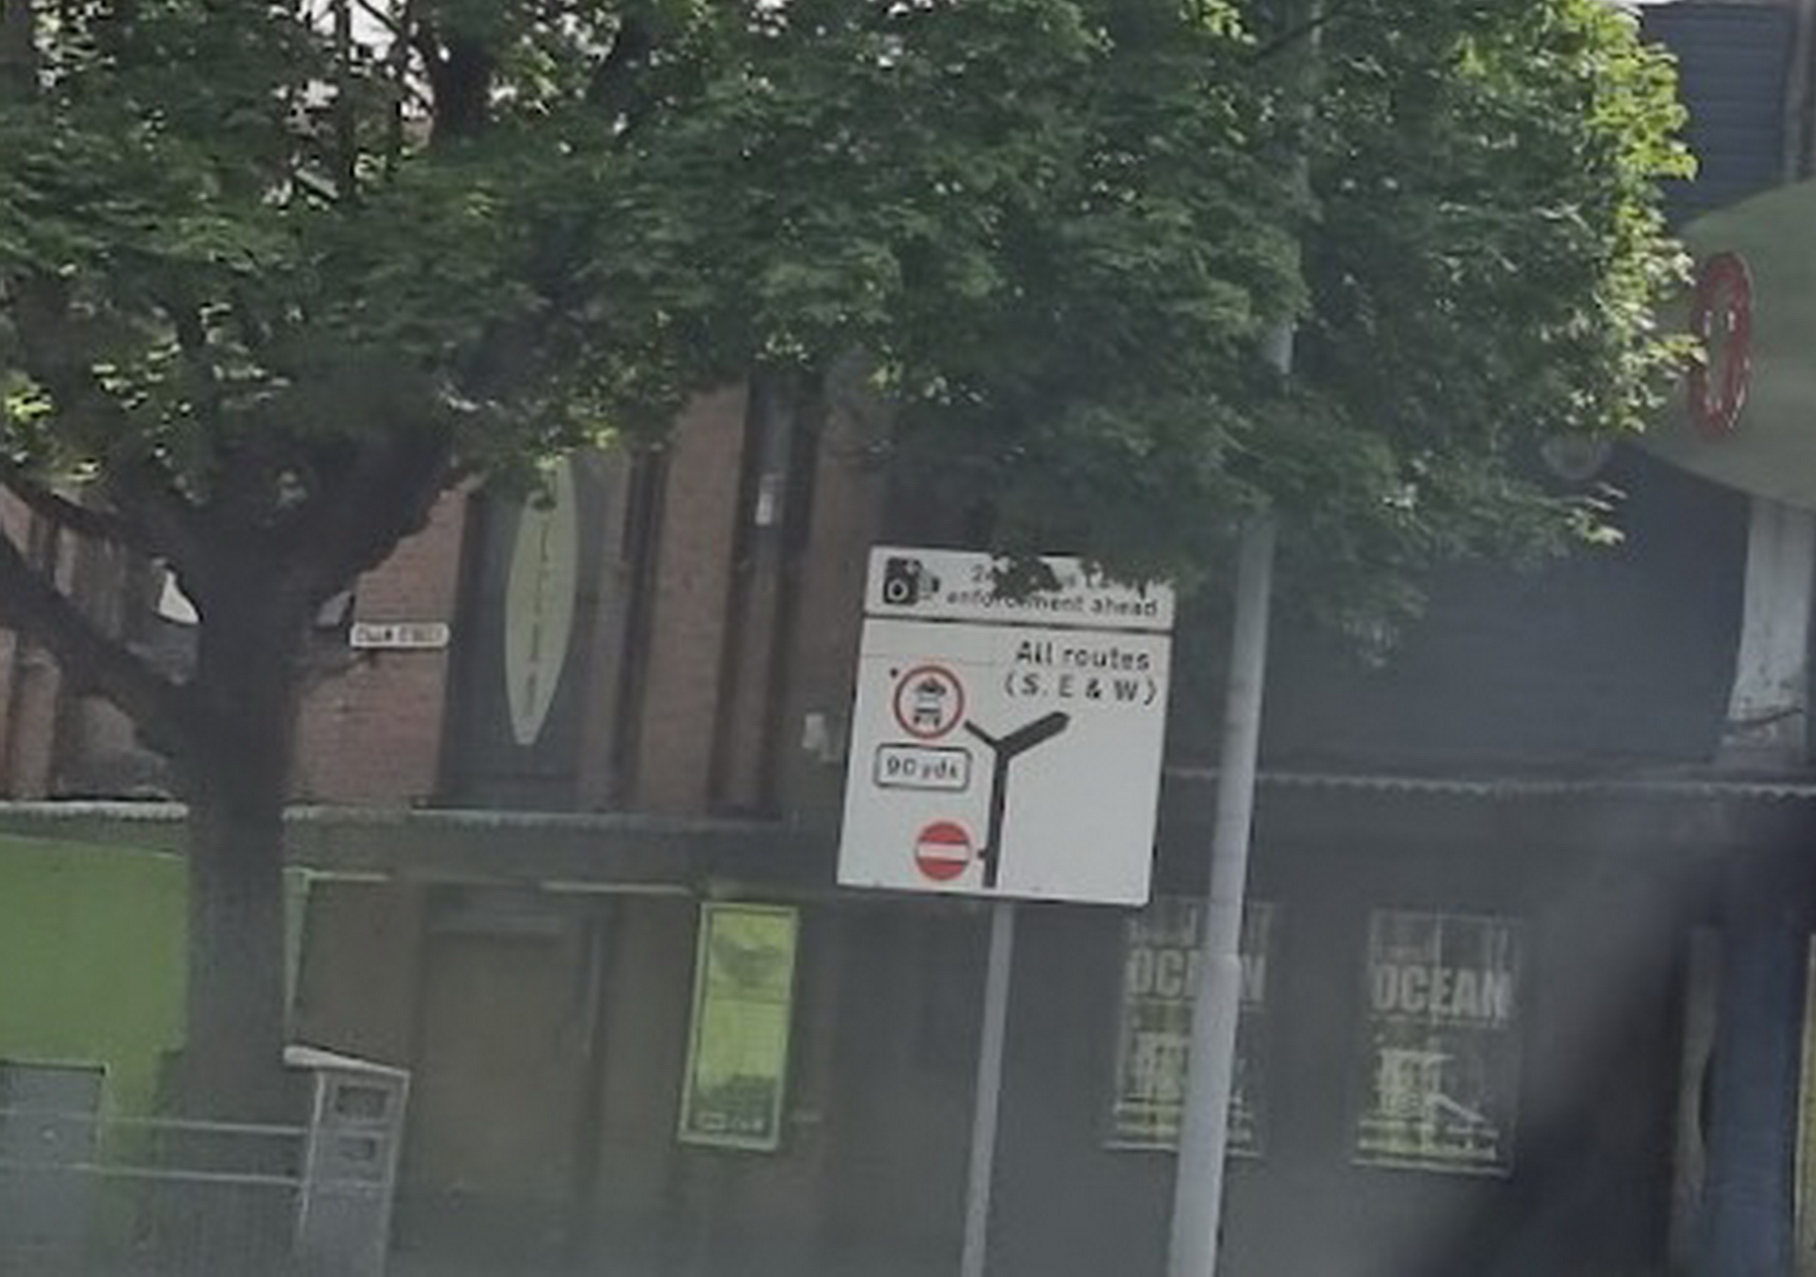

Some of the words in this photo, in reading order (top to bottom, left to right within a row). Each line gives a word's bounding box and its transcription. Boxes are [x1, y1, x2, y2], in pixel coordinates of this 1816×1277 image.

[1091, 595, 1158, 616] ahead
[1016, 641, 1053, 667] All
[1063, 645, 1150, 672] routes
[1059, 674, 1076, 697] E
[1085, 678, 1101, 700] &
[1113, 679, 1157, 705] W)
[886, 755, 917, 775] 90
[1372, 963, 1514, 1019] OCEAN
